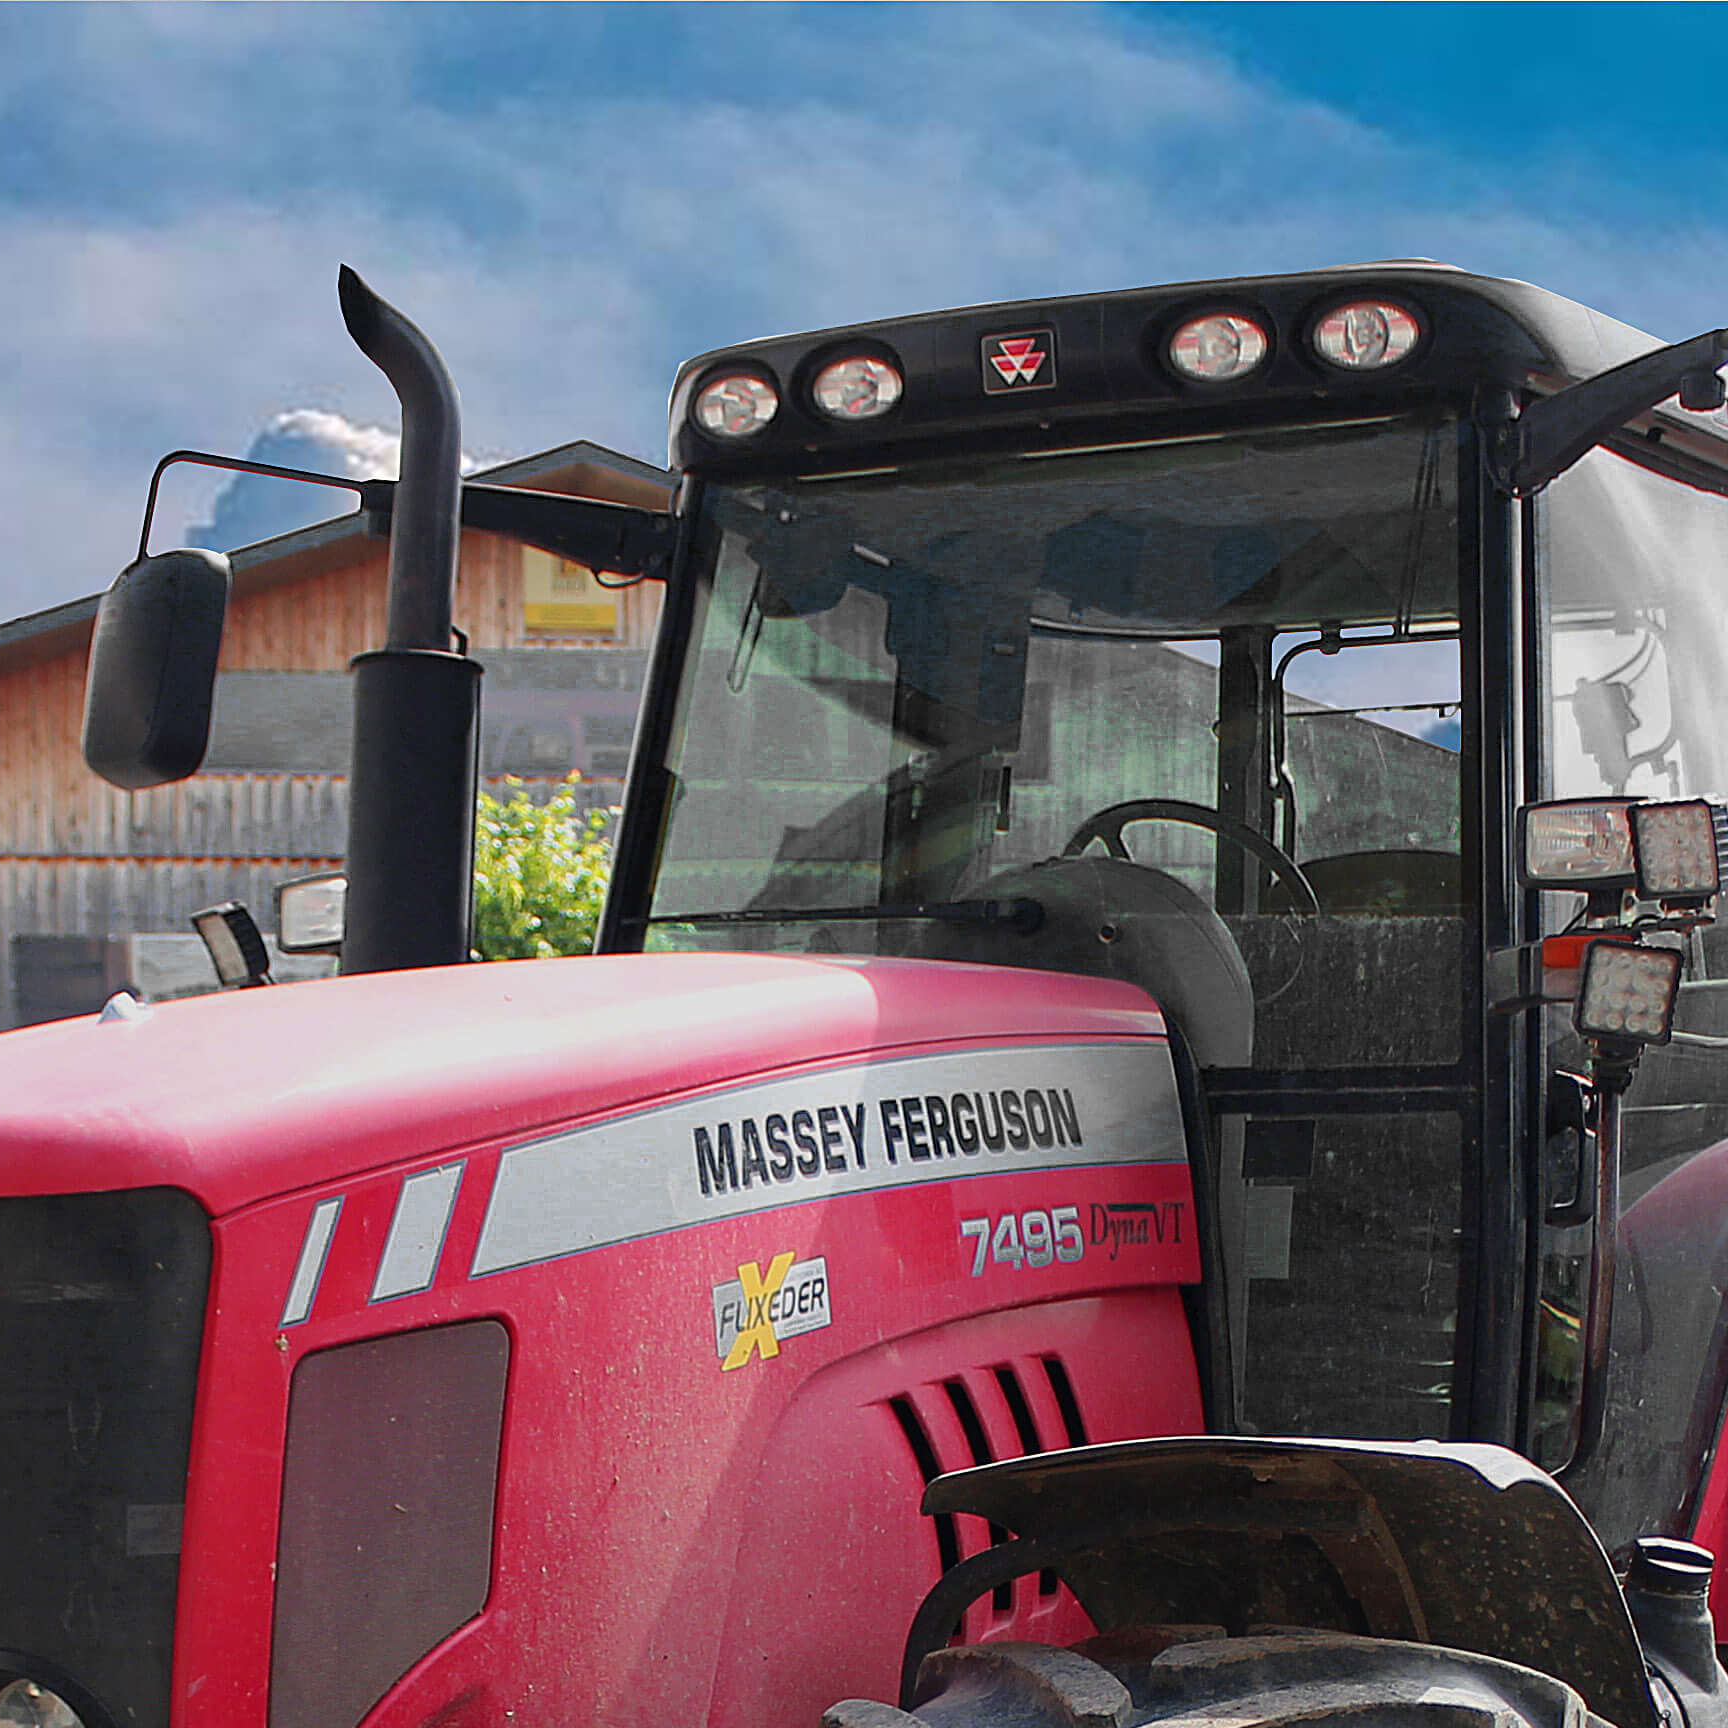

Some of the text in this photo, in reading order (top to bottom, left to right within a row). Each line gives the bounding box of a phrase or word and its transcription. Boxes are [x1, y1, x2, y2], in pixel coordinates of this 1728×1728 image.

[693, 1087, 1084, 1197] MASSEY FERGUSON
[960, 1205, 1085, 1277] 7495
